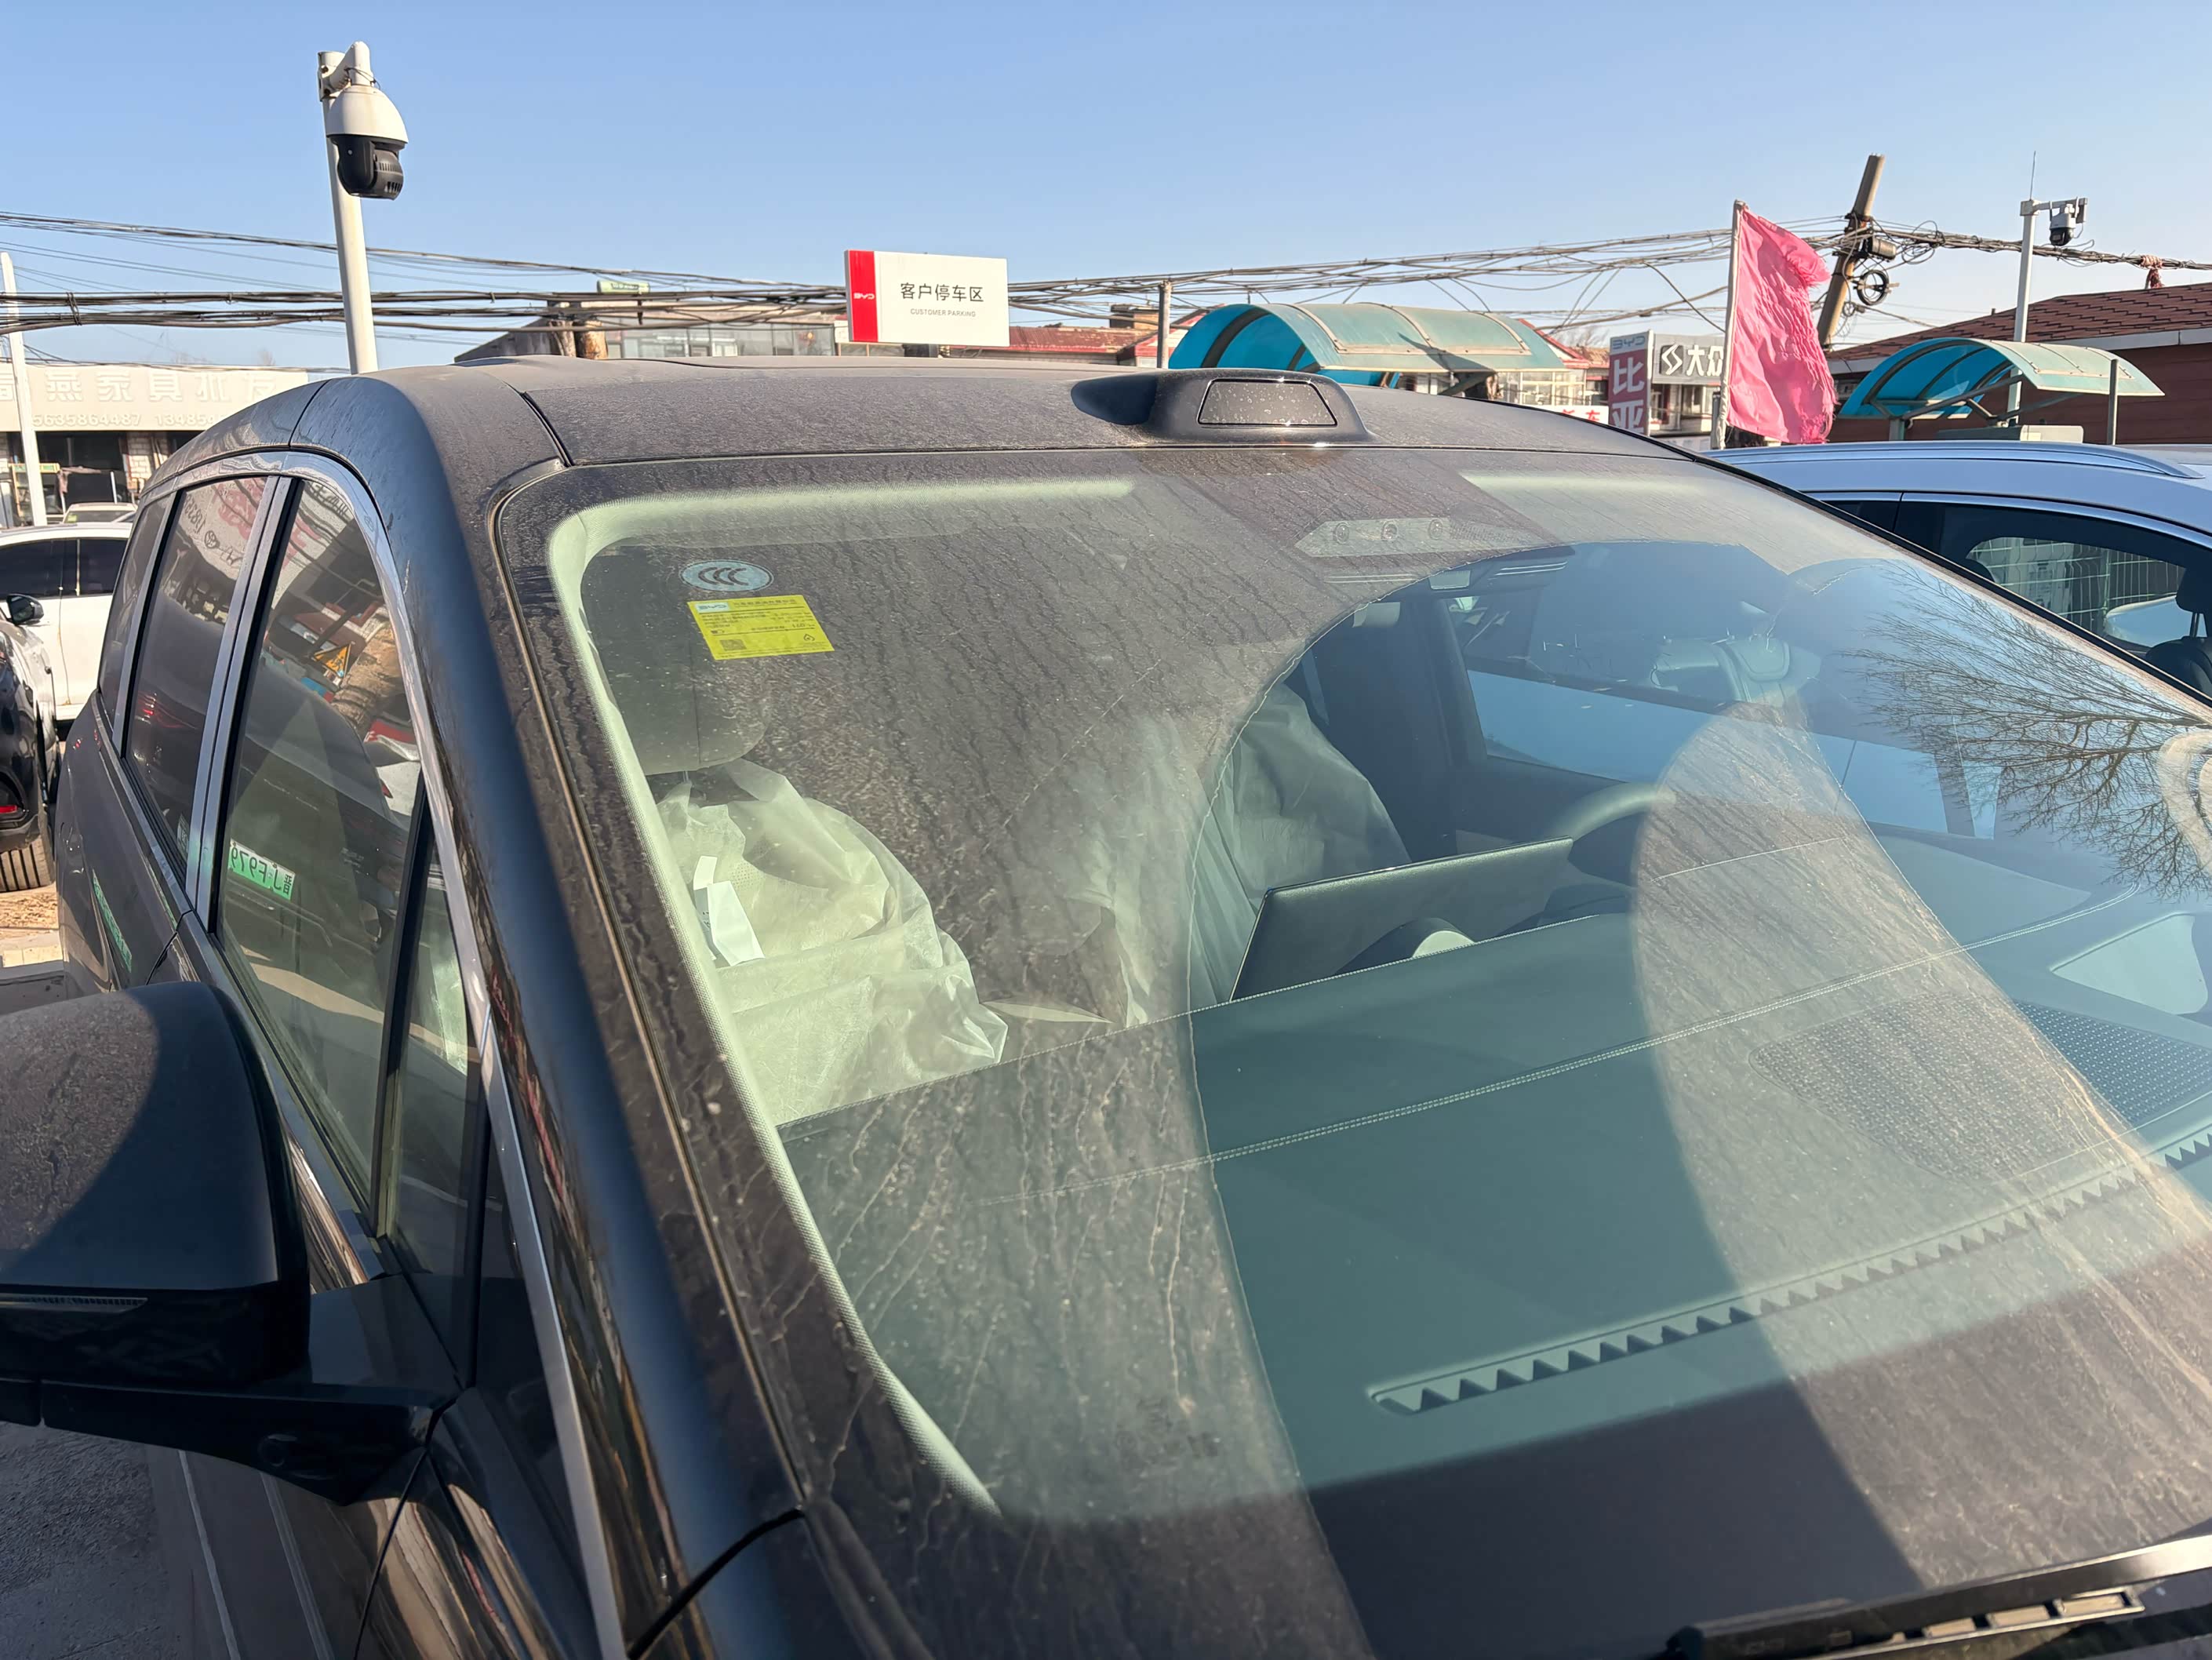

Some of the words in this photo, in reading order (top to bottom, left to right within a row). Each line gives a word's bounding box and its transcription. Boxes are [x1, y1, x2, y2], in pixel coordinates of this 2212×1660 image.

[900, 282, 984, 302] 客户停车区
[1612, 335, 1646, 350] BYD
